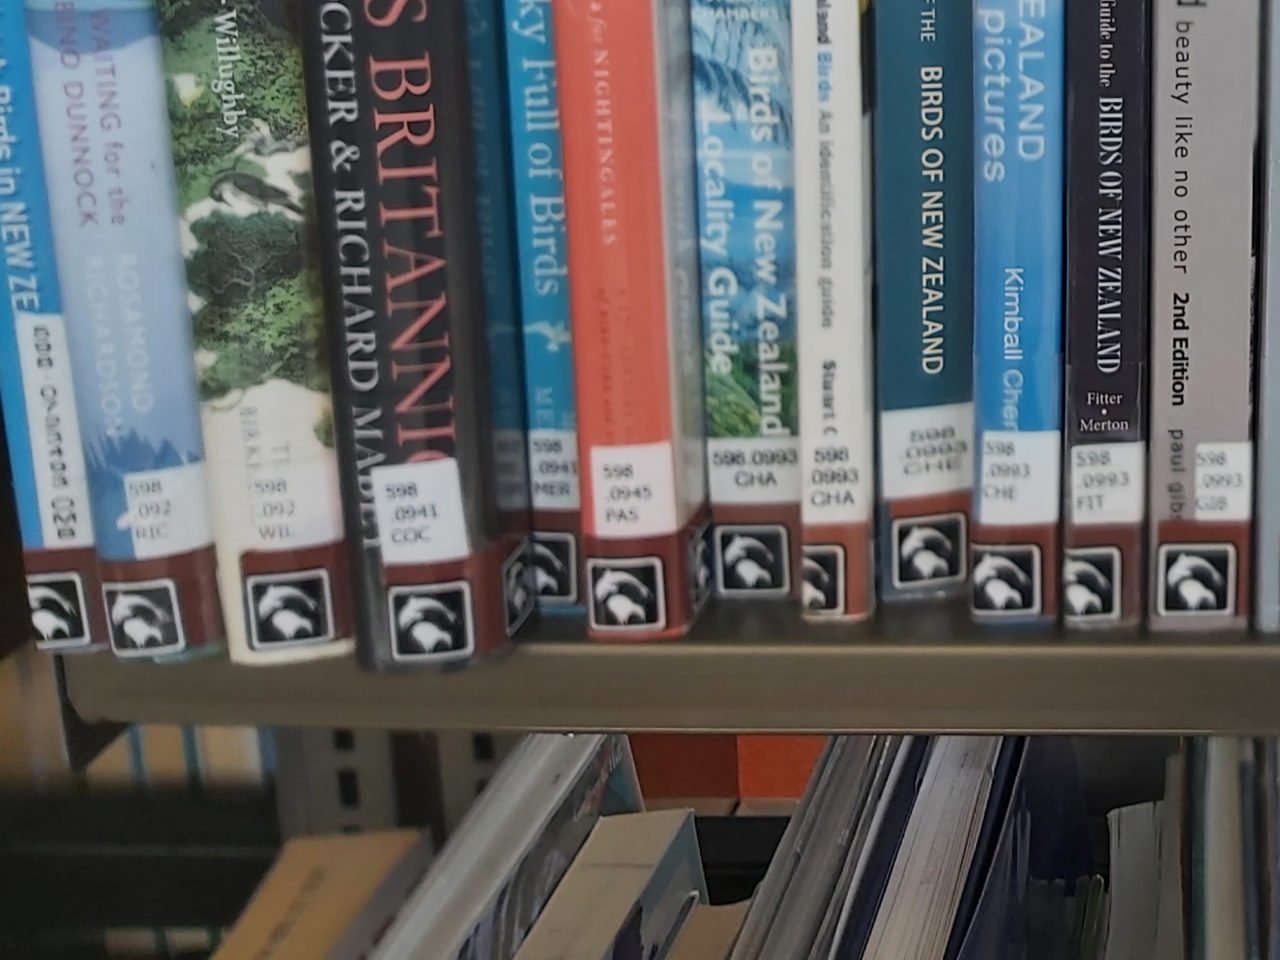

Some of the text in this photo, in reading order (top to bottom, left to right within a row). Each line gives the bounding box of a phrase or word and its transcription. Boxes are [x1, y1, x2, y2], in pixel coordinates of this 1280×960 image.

[920, 8, 936, 42] THE
[1099, 44, 1116, 60] to
[211, 9, 248, 139] Willughby
[522, 58, 560, 132] Full
[816, 51, 832, 103] Birds
[978, 8, 1012, 182] pictures
[1099, 62, 1117, 87] the
[1171, 21, 1195, 105] beauty
[89, 8, 131, 227] WAITING for the
[593, 49, 618, 246] NIGHTINGALES
[818, 109, 833, 134] An
[1099, 97, 1123, 166] BIRDS
[1174, 115, 1194, 159] like
[63, 81, 98, 227] DUNNOCK
[331, 141, 361, 173] &
[528, 142, 564, 180] of
[1098, 171, 1123, 200] OF
[1174, 170, 1189, 199] no
[1, 201, 33, 269] NEW
[530, 193, 568, 297] Birds
[701, 110, 740, 375] Locality Guide
[749, 46, 791, 437] Birds of New Zealand
[920, 65, 944, 375] BIRDS OF NEW ZEALAND
[1098, 207, 1123, 260] NEW
[1173, 209, 1192, 275] other
[370, 51, 457, 462] BRITANNI
[335, 188, 381, 392] RICHARD
[817, 276, 834, 328] guide
[1003, 266, 1025, 361] Kimball
[1096, 266, 1123, 374] ZEALAND
[1172, 292, 1190, 331] 2nd
[822, 359, 837, 420] Stuart
[1086, 391, 1123, 406] Fitter
[1171, 337, 1189, 407] Edition
[1079, 418, 1129, 432] Merton
[1167, 428, 1186, 473] paul
[604, 509, 639, 523] PAS
